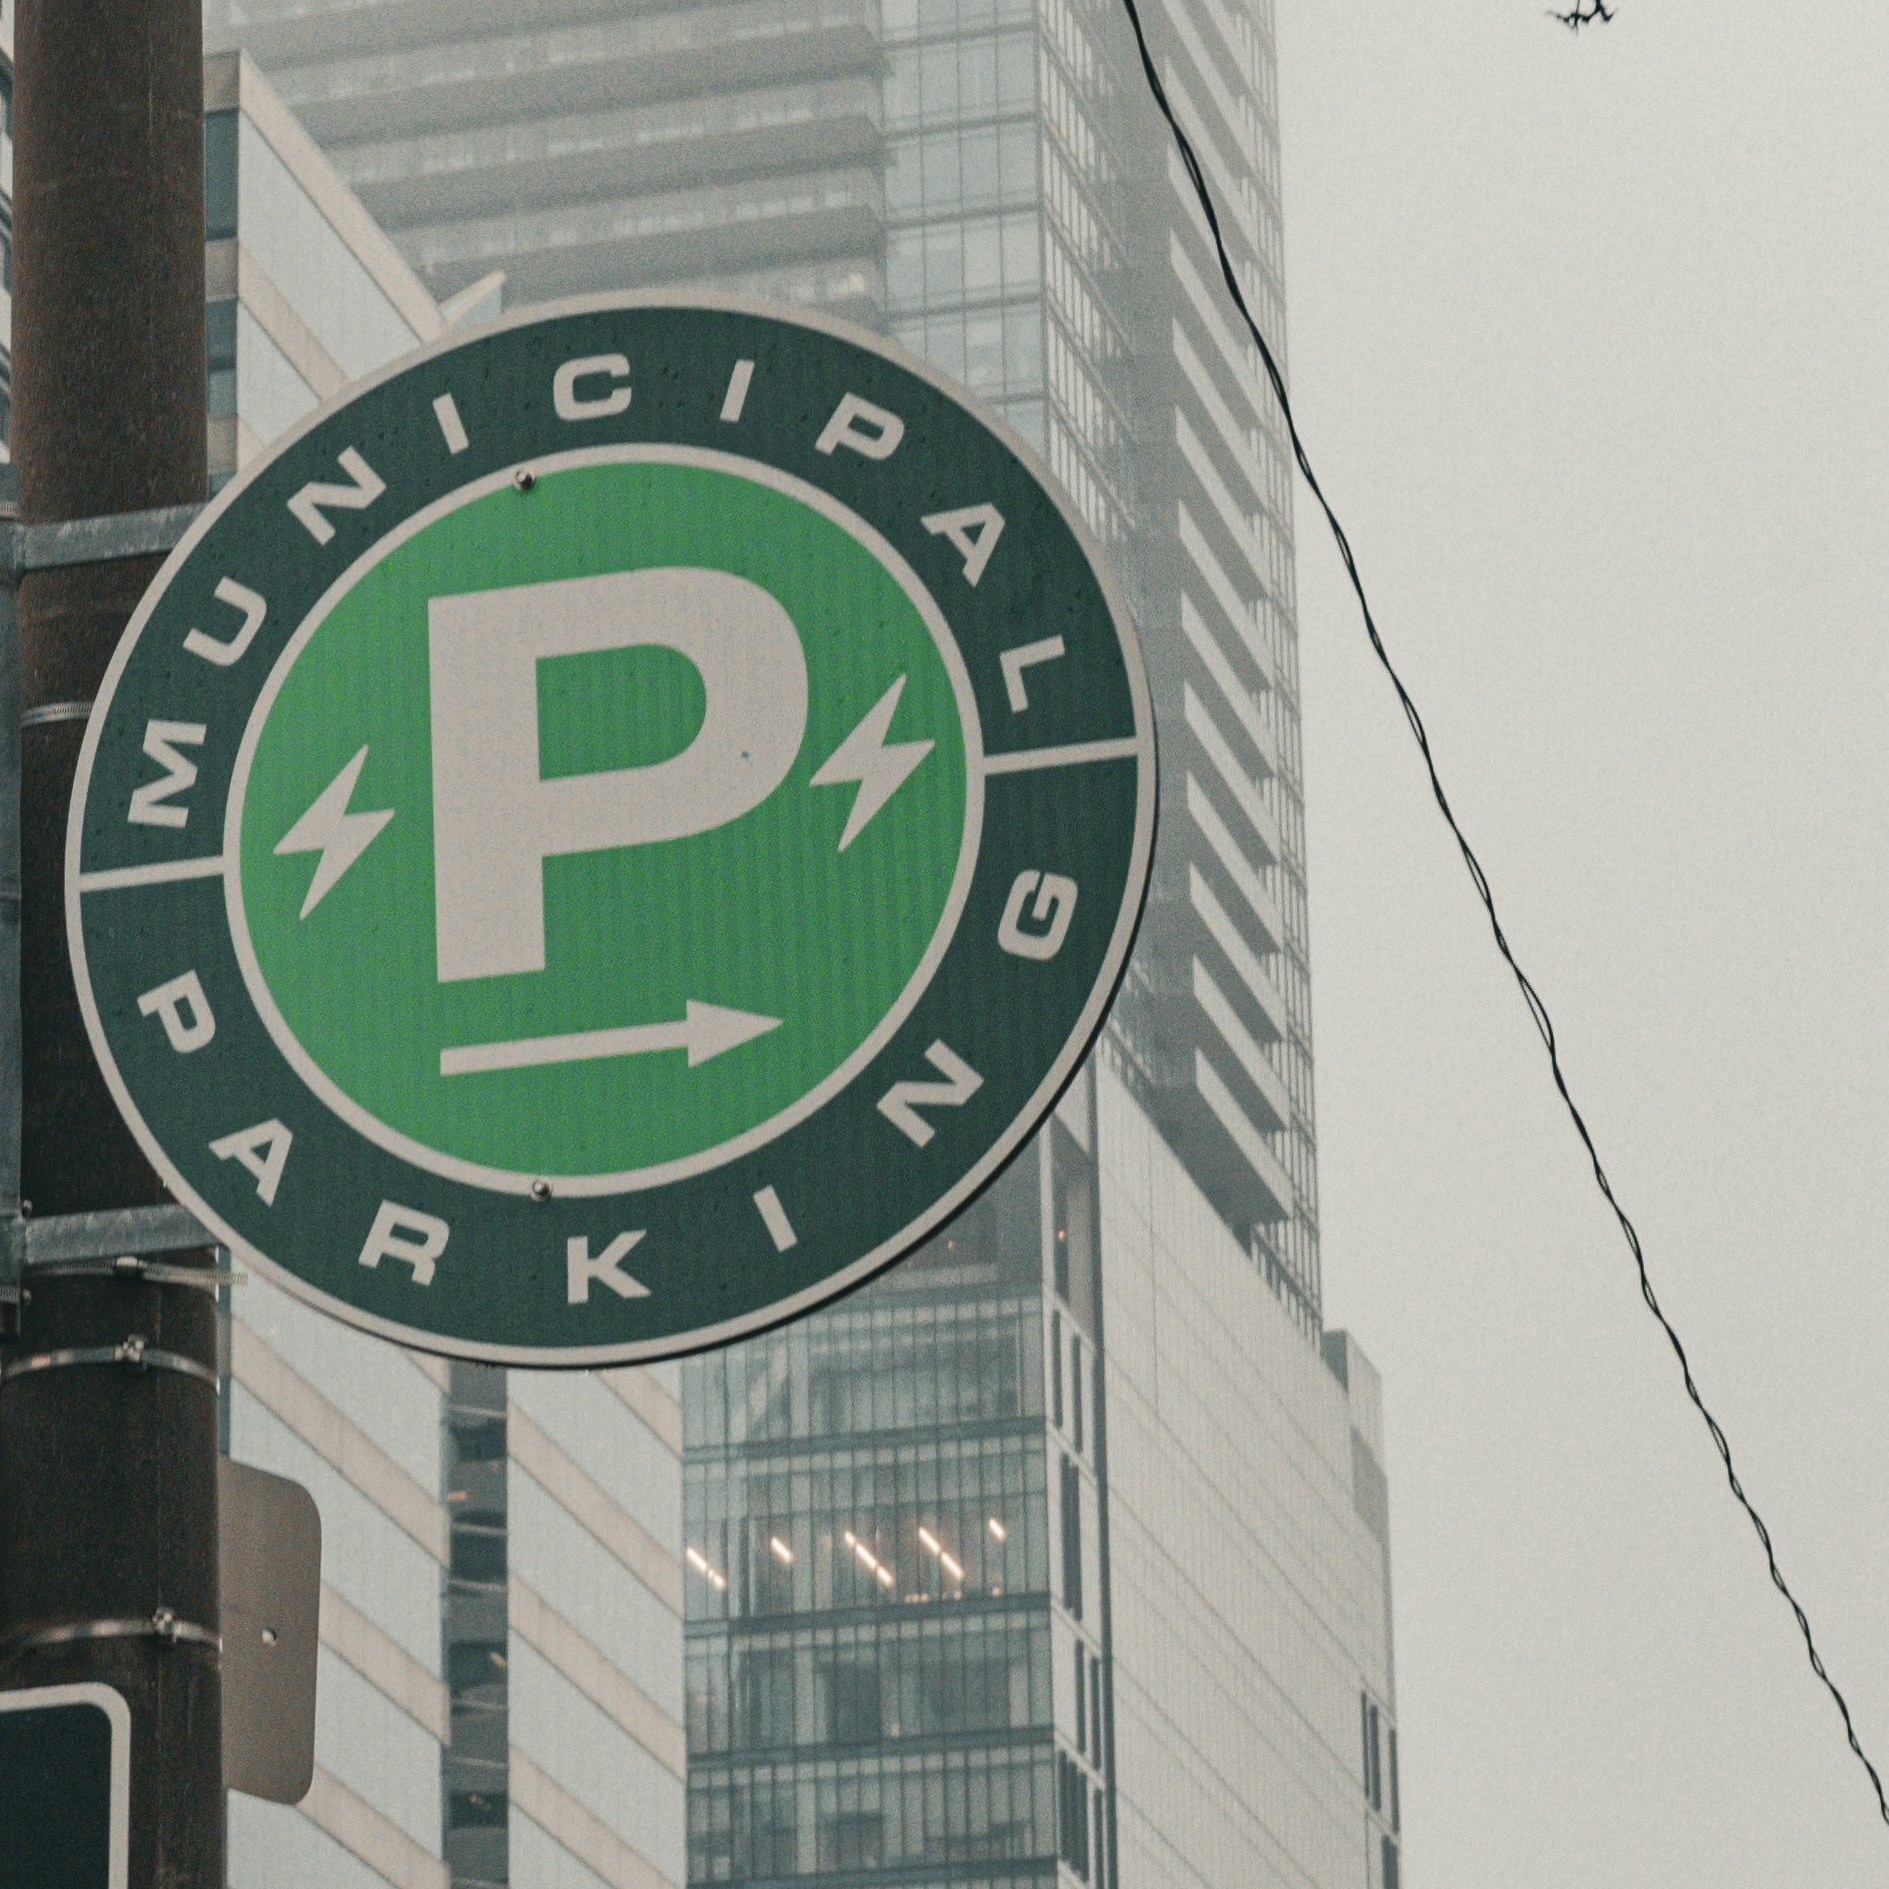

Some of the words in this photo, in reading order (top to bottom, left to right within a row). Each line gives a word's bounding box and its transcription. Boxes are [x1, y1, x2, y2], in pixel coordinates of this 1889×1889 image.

[126, 353, 1065, 828] MUNICIPAL
[426, 565, 810, 984] P
[136, 868, 1079, 1304] PARKING
